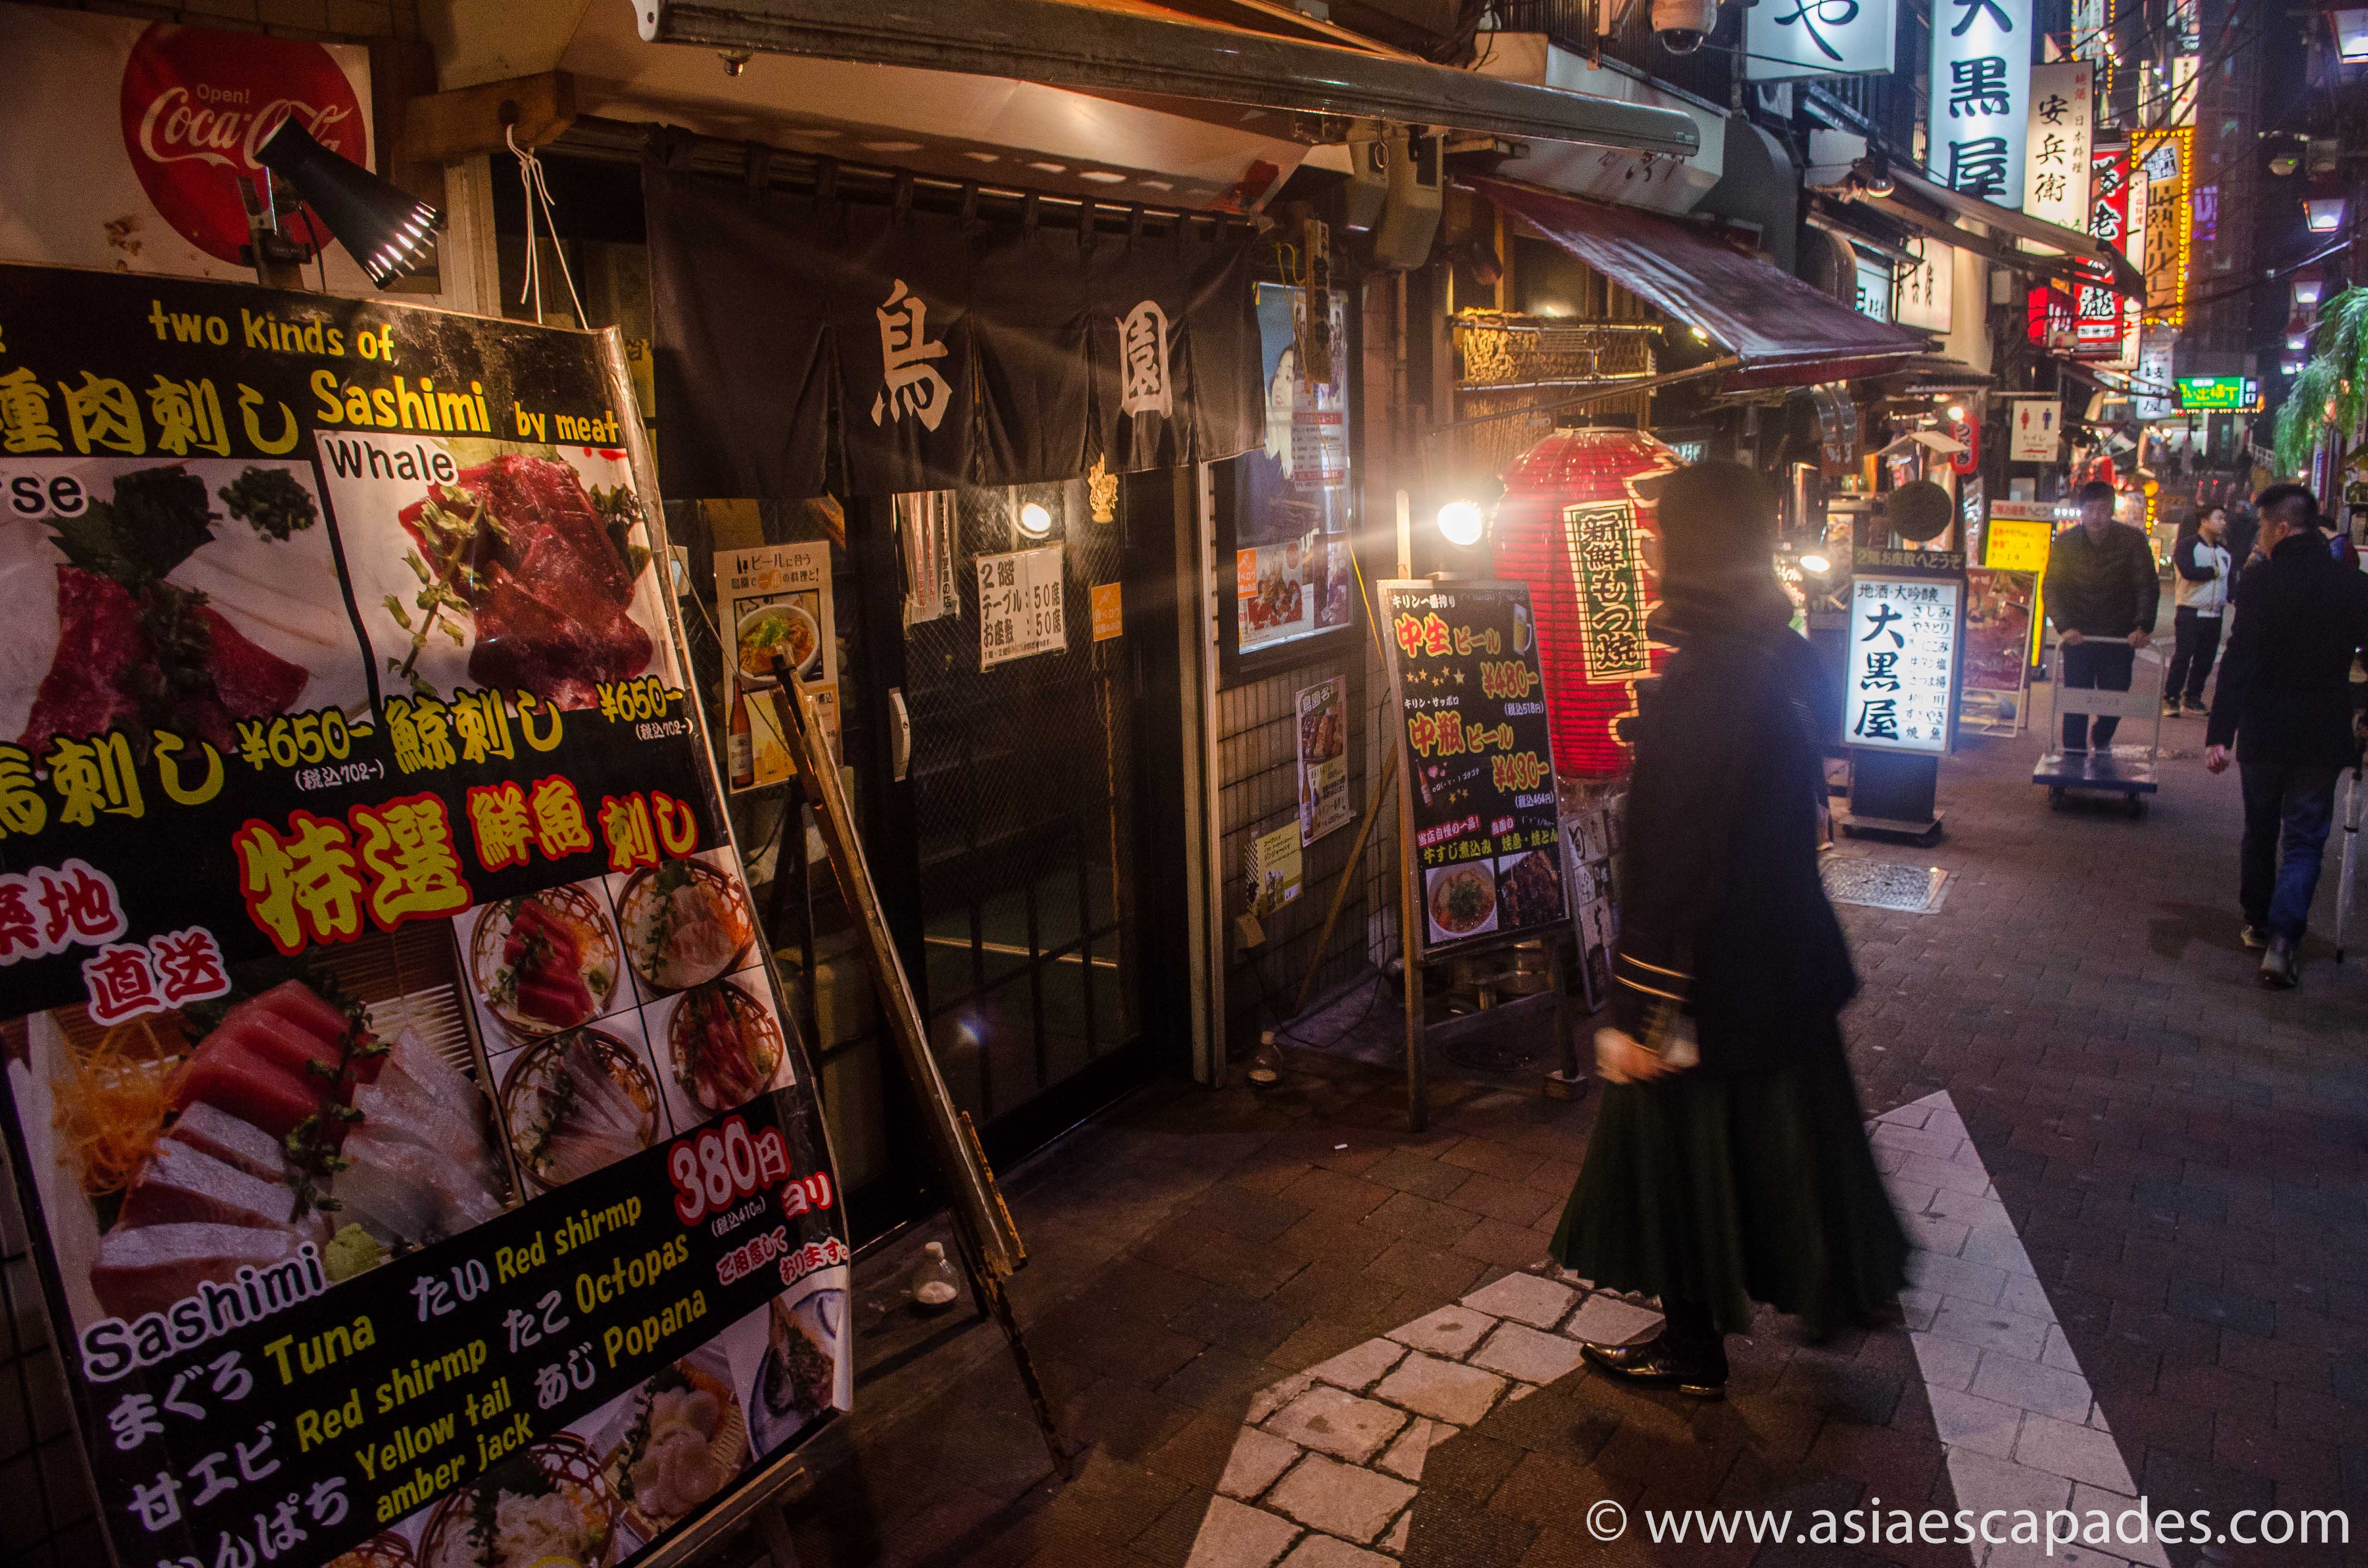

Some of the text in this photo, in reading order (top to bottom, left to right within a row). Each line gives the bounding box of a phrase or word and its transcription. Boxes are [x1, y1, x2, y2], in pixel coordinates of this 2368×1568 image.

[197, 83, 250, 104] Open!
[2035, 94, 2069, 204] 安兵衛
[148, 300, 395, 362] two kinds of
[871, 279, 953, 432] 鳥
[310, 369, 619, 444] Sashimi by meat
[0, 476, 84, 514] se
[324, 439, 455, 483] Whale
[980, 560, 1015, 589] 2階
[1393, 594, 1456, 609] キリン一番搾り
[1579, 512, 1640, 670] 新鮮もつ焼
[1857, 583, 1940, 602] 地酒・大吟醸
[1912, 603, 1952, 619] さしみ
[1394, 612, 1502, 659] 中生ビール
[1912, 621, 1949, 635] やきとり
[1404, 695, 1459, 709] キリン・サッポロ
[1853, 602, 1905, 741] 大黒屋
[385, 689, 563, 774] 鯨刺し
[1408, 710, 1514, 758] 中瓶ビール
[1417, 815, 1481, 848] 当店自慢の一品!
[1423, 838, 1492, 865] 牛すじ煮込み
[237, 795, 471, 952] 特選
[89, 931, 227, 1020] 直送
[672, 1121, 787, 1220] 380円
[409, 1195, 642, 1323] たい Red shirmp
[716, 1225, 789, 1286] ご用意して
[779, 1237, 849, 1286] おります。
[84, 1245, 324, 1378] Sashimi
[502, 1233, 689, 1354] たこ Octopas
[107, 1315, 376, 1451] まぐろ Tuna
[533, 1289, 707, 1411] あじ Popana
[127, 1338, 488, 1532] 甘エビ Red shirmp
[156, 1377, 511, 1568] んぱち Yellow tail
[377, 1412, 534, 1523] amber jack
